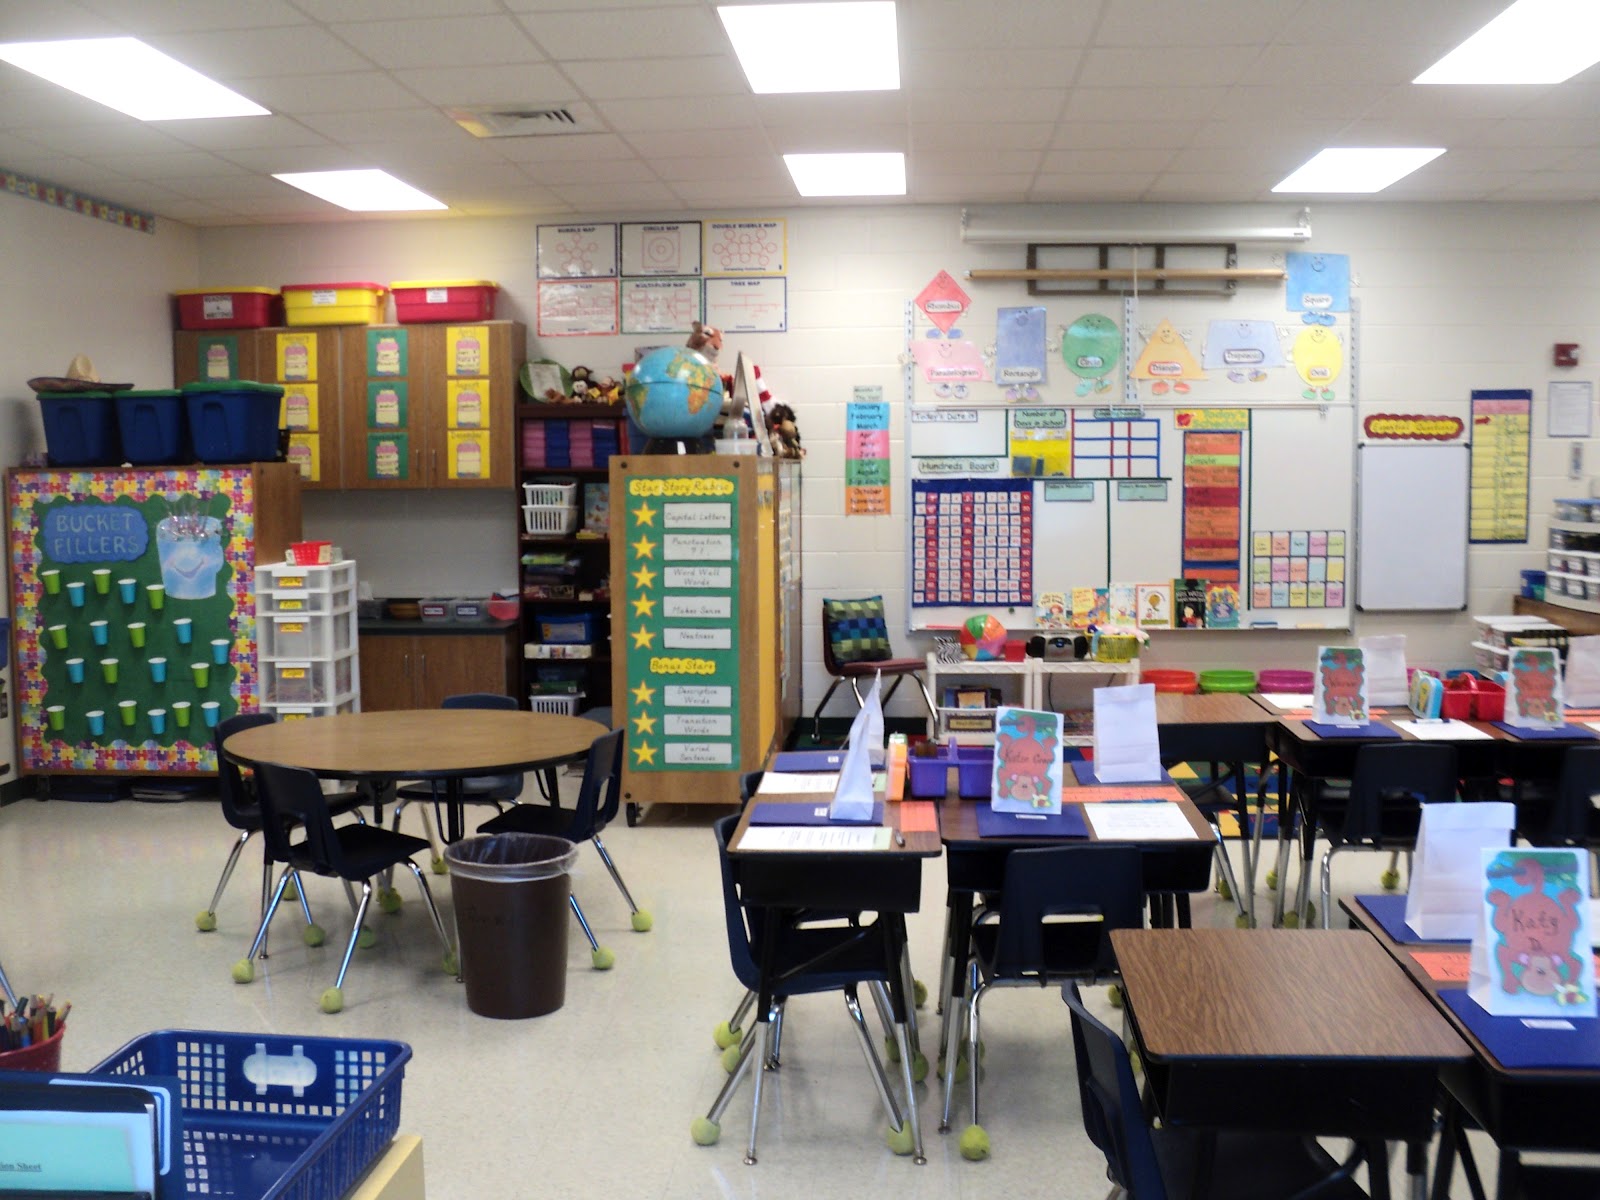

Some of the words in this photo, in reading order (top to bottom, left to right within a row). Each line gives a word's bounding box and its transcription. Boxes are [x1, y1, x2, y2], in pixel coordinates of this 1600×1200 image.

[1003, 369, 1039, 379] Rectangle
[921, 461, 963, 470] Hundreds
[969, 461, 996, 470] Board
[634, 481, 659, 492] Star
[663, 480, 691, 494] Story
[56, 512, 136, 532] BUCKET
[664, 512, 696, 524] Capital
[699, 513, 727, 521] Letters
[54, 535, 140, 556] FILLERS
[673, 568, 696, 577] Word
[683, 578, 710, 586] Words
[699, 606, 721, 614] Sense
[679, 631, 715, 640] Neatness
[651, 660, 681, 670] Bonus
[685, 660, 714, 671] Stars
[683, 725, 710, 734] Words
[16, 1162, 42, 1170] Sheet
